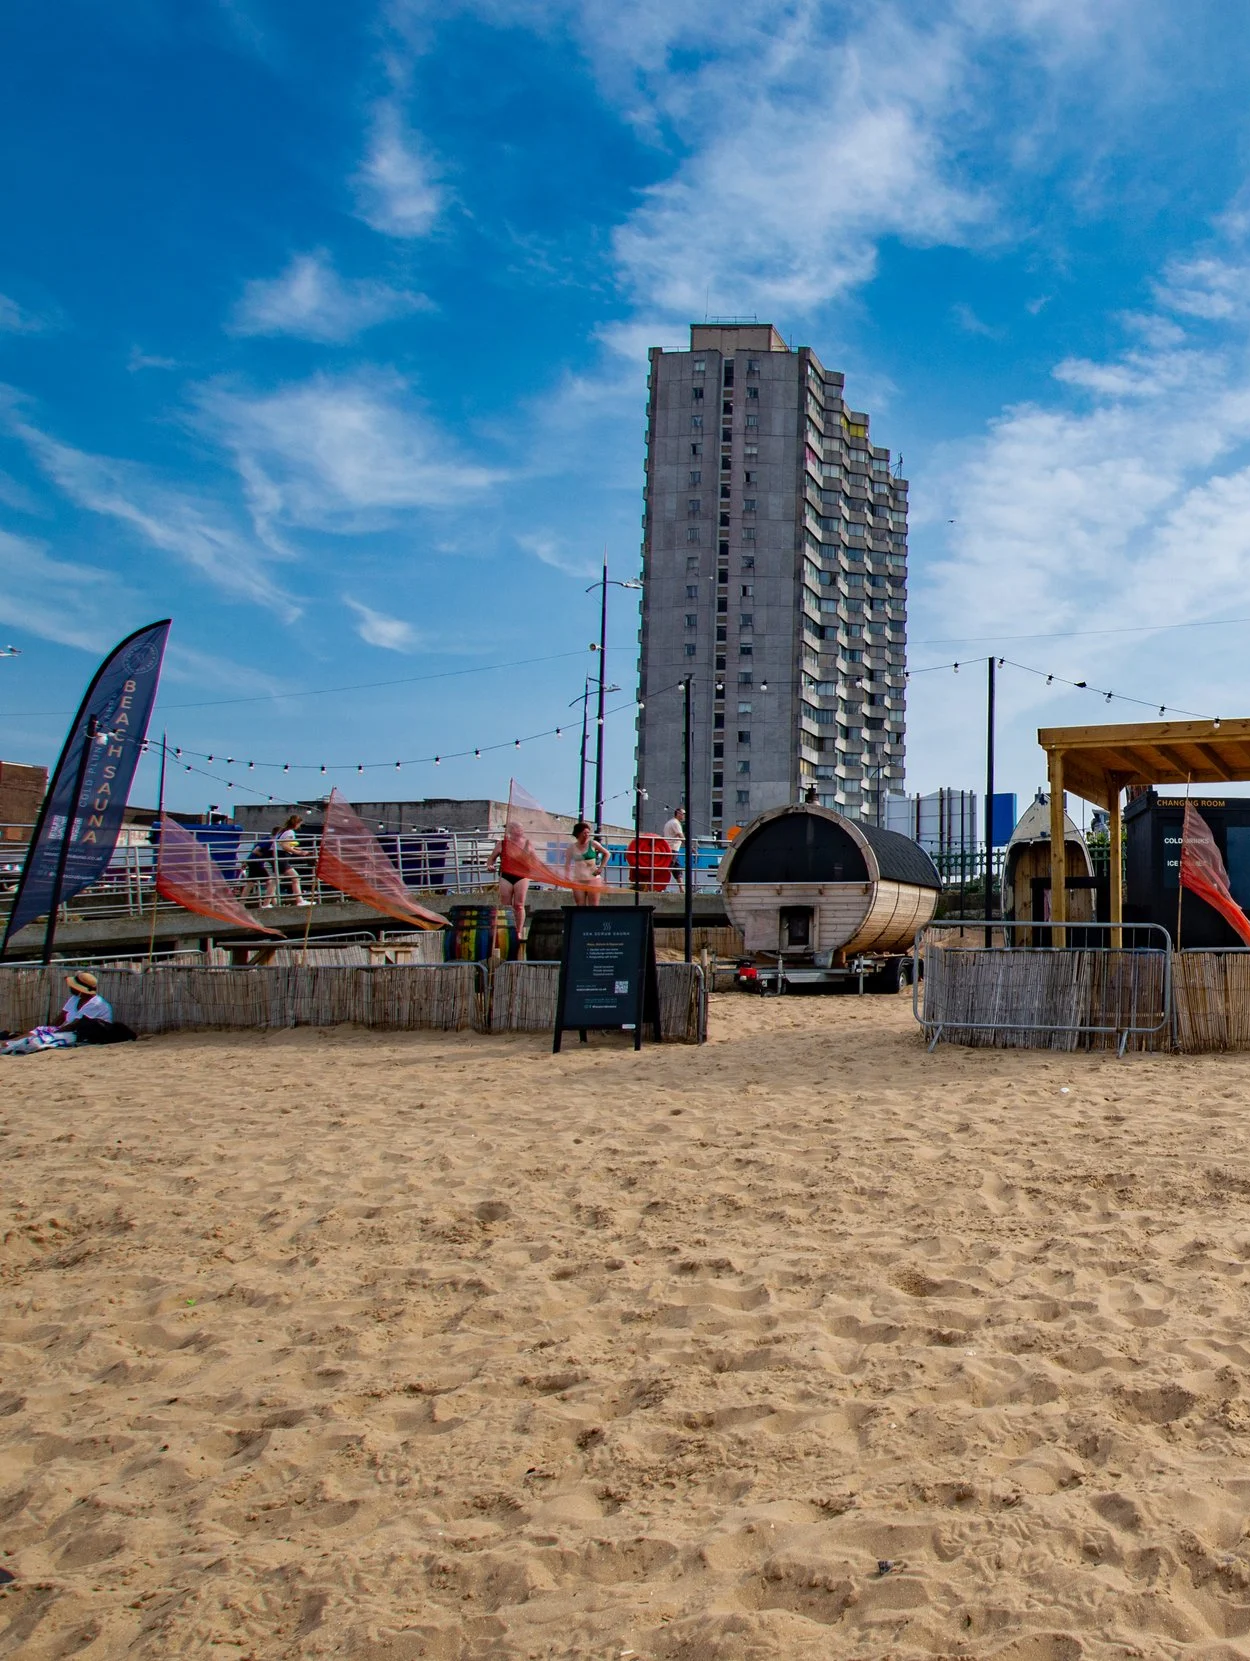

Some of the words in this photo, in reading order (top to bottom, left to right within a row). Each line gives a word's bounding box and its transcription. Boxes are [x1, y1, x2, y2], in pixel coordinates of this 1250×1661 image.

[107, 680, 137, 758] BEACH
[79, 779, 93, 808] COLD
[82, 765, 117, 844] SAUNA
[1156, 799, 1199, 807] CHANGNG
